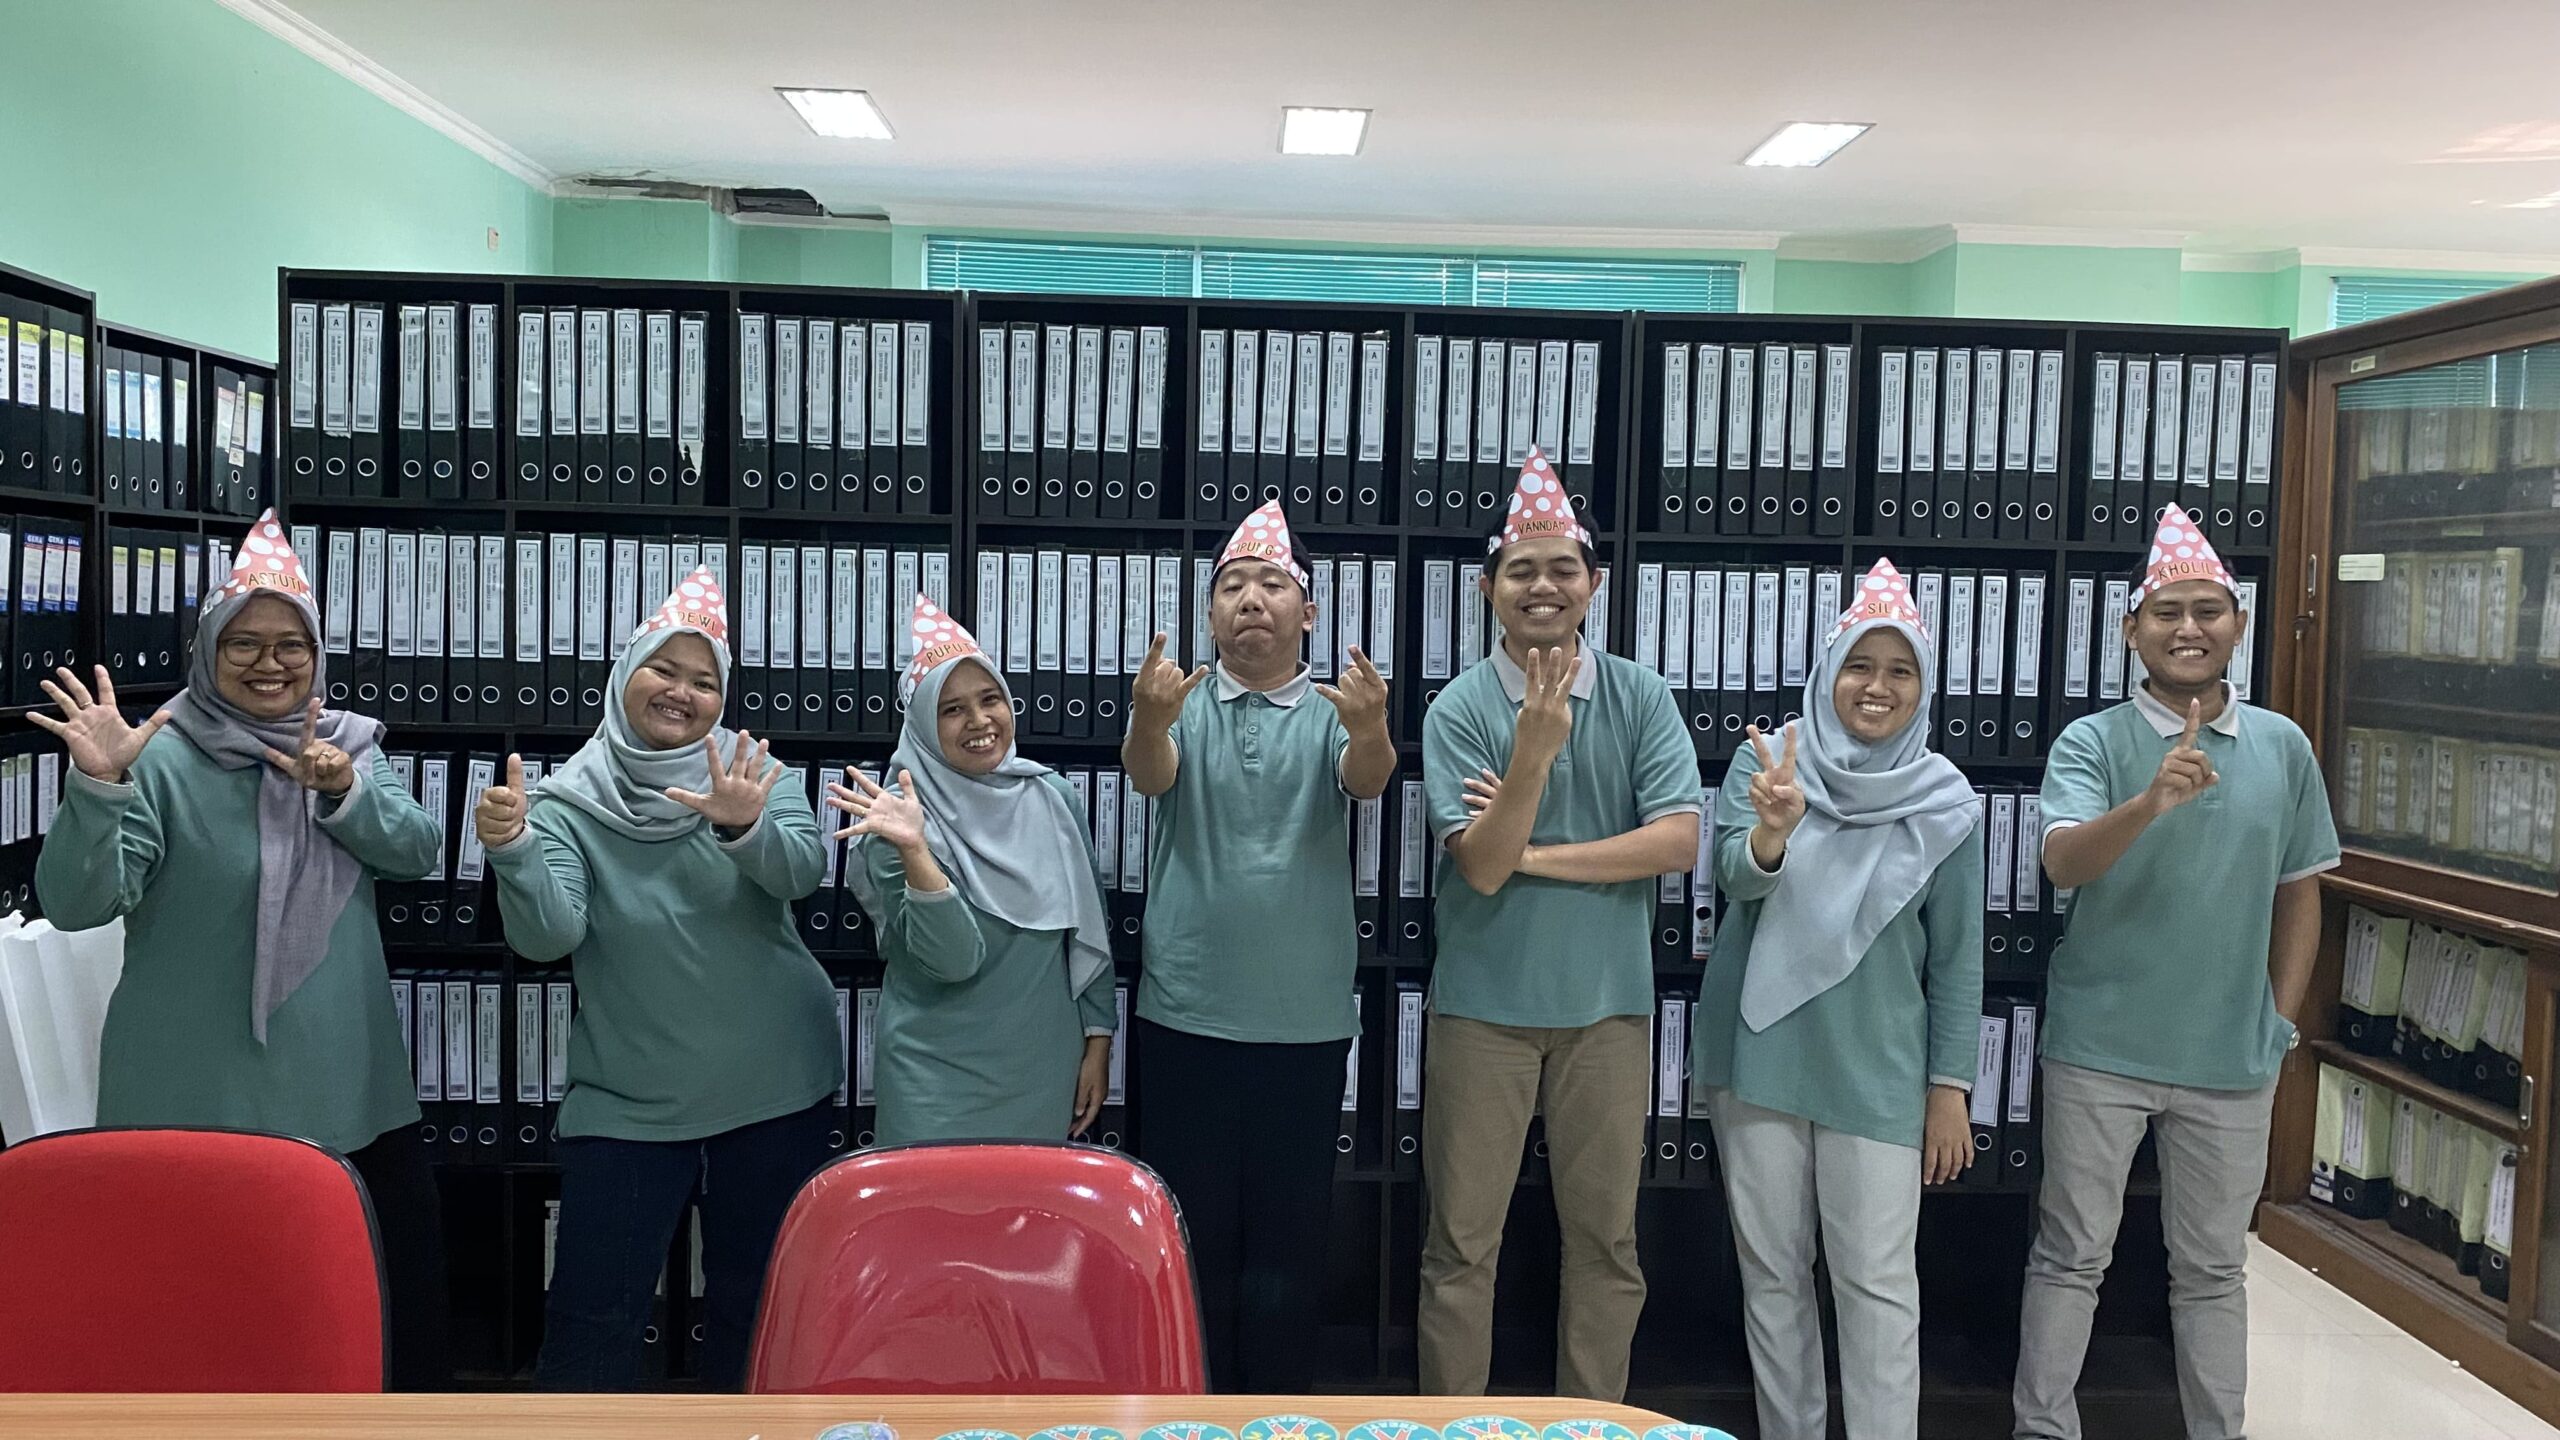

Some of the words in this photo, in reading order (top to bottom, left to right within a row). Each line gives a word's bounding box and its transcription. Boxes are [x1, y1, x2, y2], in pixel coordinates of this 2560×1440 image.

[2157, 561, 2213, 580] KHOLIL
[248, 572, 301, 591] ASTUTI
[677, 611, 716, 631] DEWI
[926, 642, 972, 663] PUPUT
